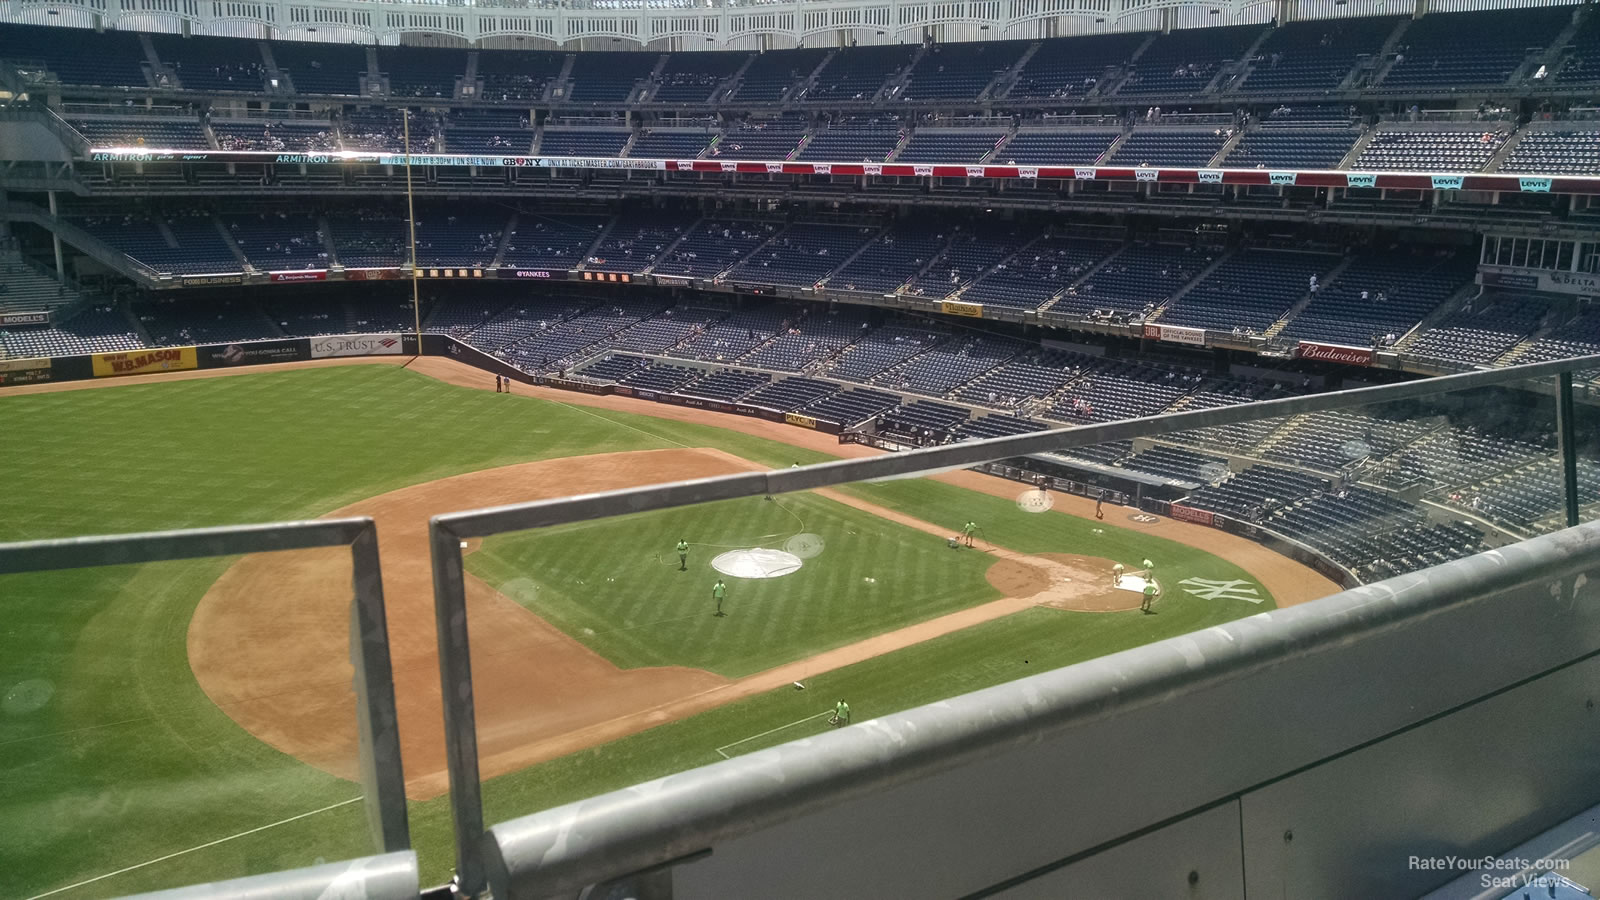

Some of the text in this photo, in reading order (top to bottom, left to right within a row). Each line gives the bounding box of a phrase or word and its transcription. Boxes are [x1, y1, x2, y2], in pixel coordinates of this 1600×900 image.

[276, 155, 328, 163] ARMITRON
[466, 157, 479, 165] SALE
[1564, 279, 1595, 287] DELTA
[4, 314, 45, 323] MODELL'S
[1145, 326, 1160, 337] JBL
[315, 340, 376, 352] U.S. TRUST
[1300, 344, 1370, 363] Budweiser
